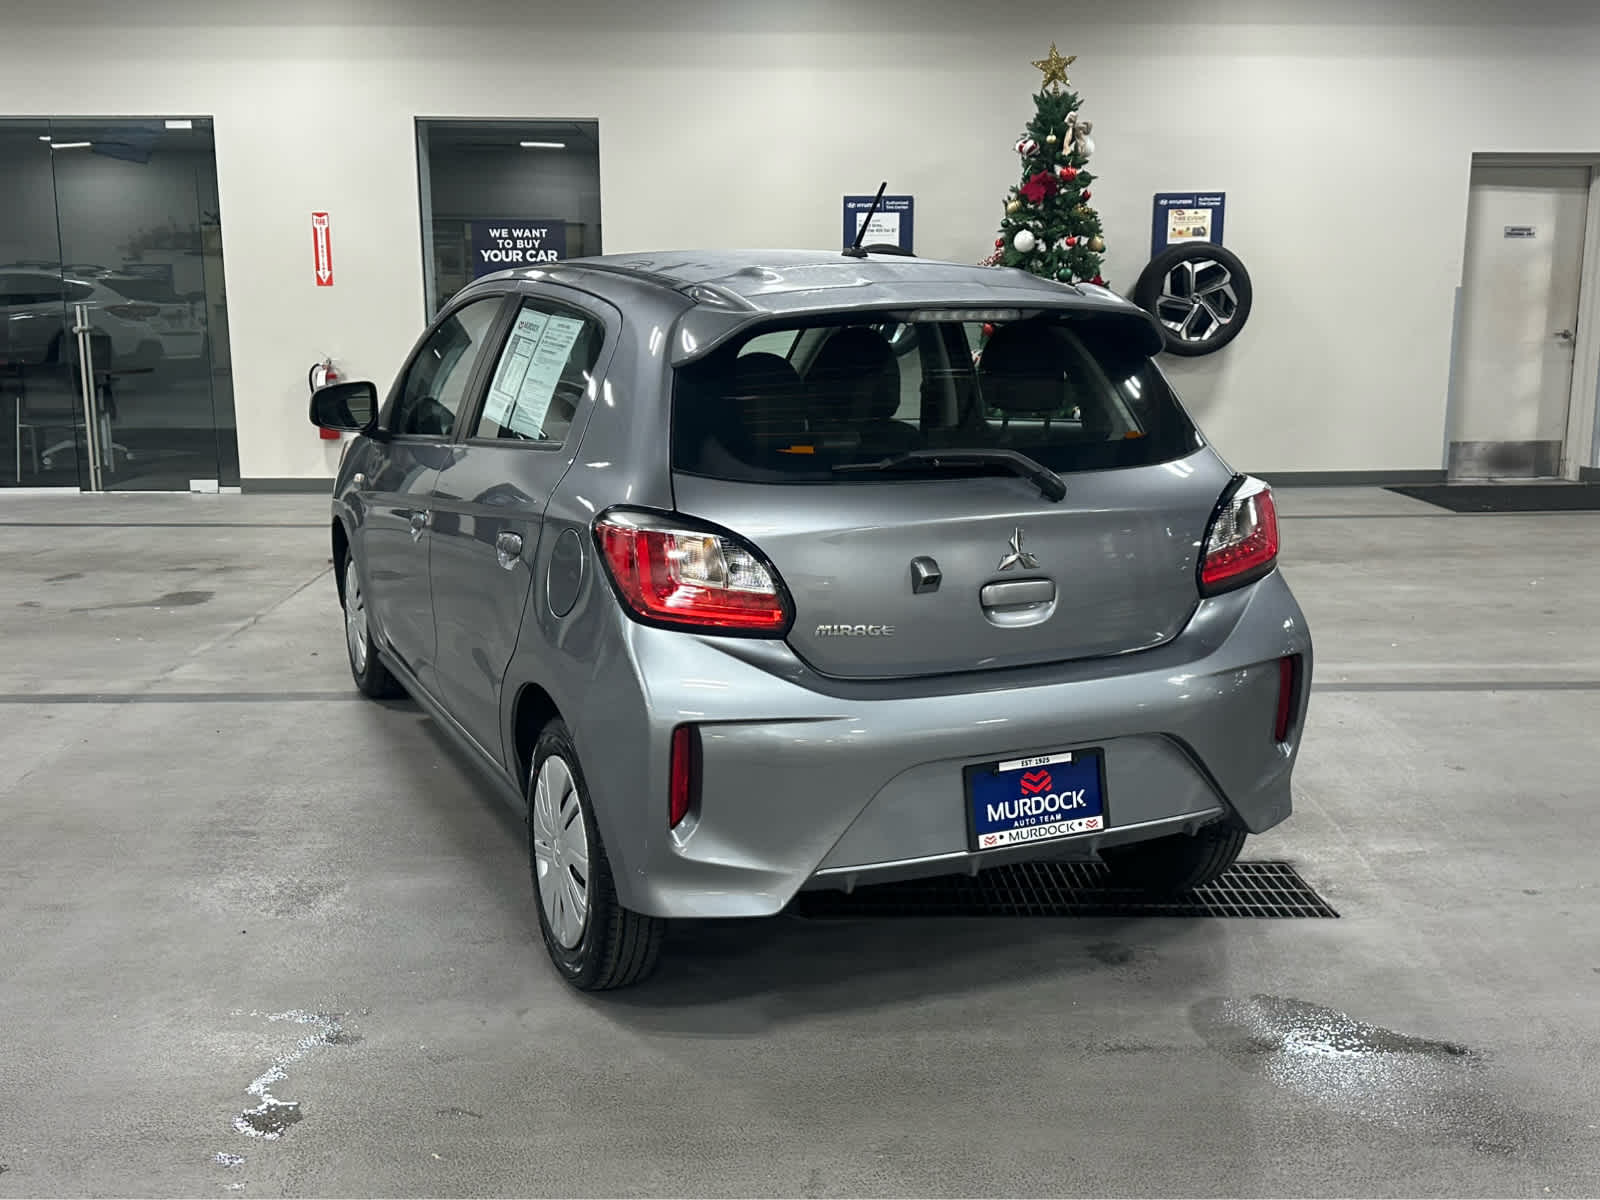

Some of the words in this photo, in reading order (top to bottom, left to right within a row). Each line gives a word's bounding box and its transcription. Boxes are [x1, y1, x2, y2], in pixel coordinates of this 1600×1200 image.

[488, 228, 509, 238] WE
[511, 228, 548, 238] WANT
[496, 239, 513, 249] TO
[516, 239, 541, 249] BUY
[480, 249, 523, 262] YOUR
[525, 249, 558, 262] CAR
[815, 624, 896, 637] MIRAGE
[1035, 757, 1050, 765] 1925
[987, 789, 1086, 822] MURDOCK
[1013, 818, 1036, 827] AUTO
[1040, 813, 1062, 823] TEAM
[1008, 821, 1076, 842] MURDOCK
